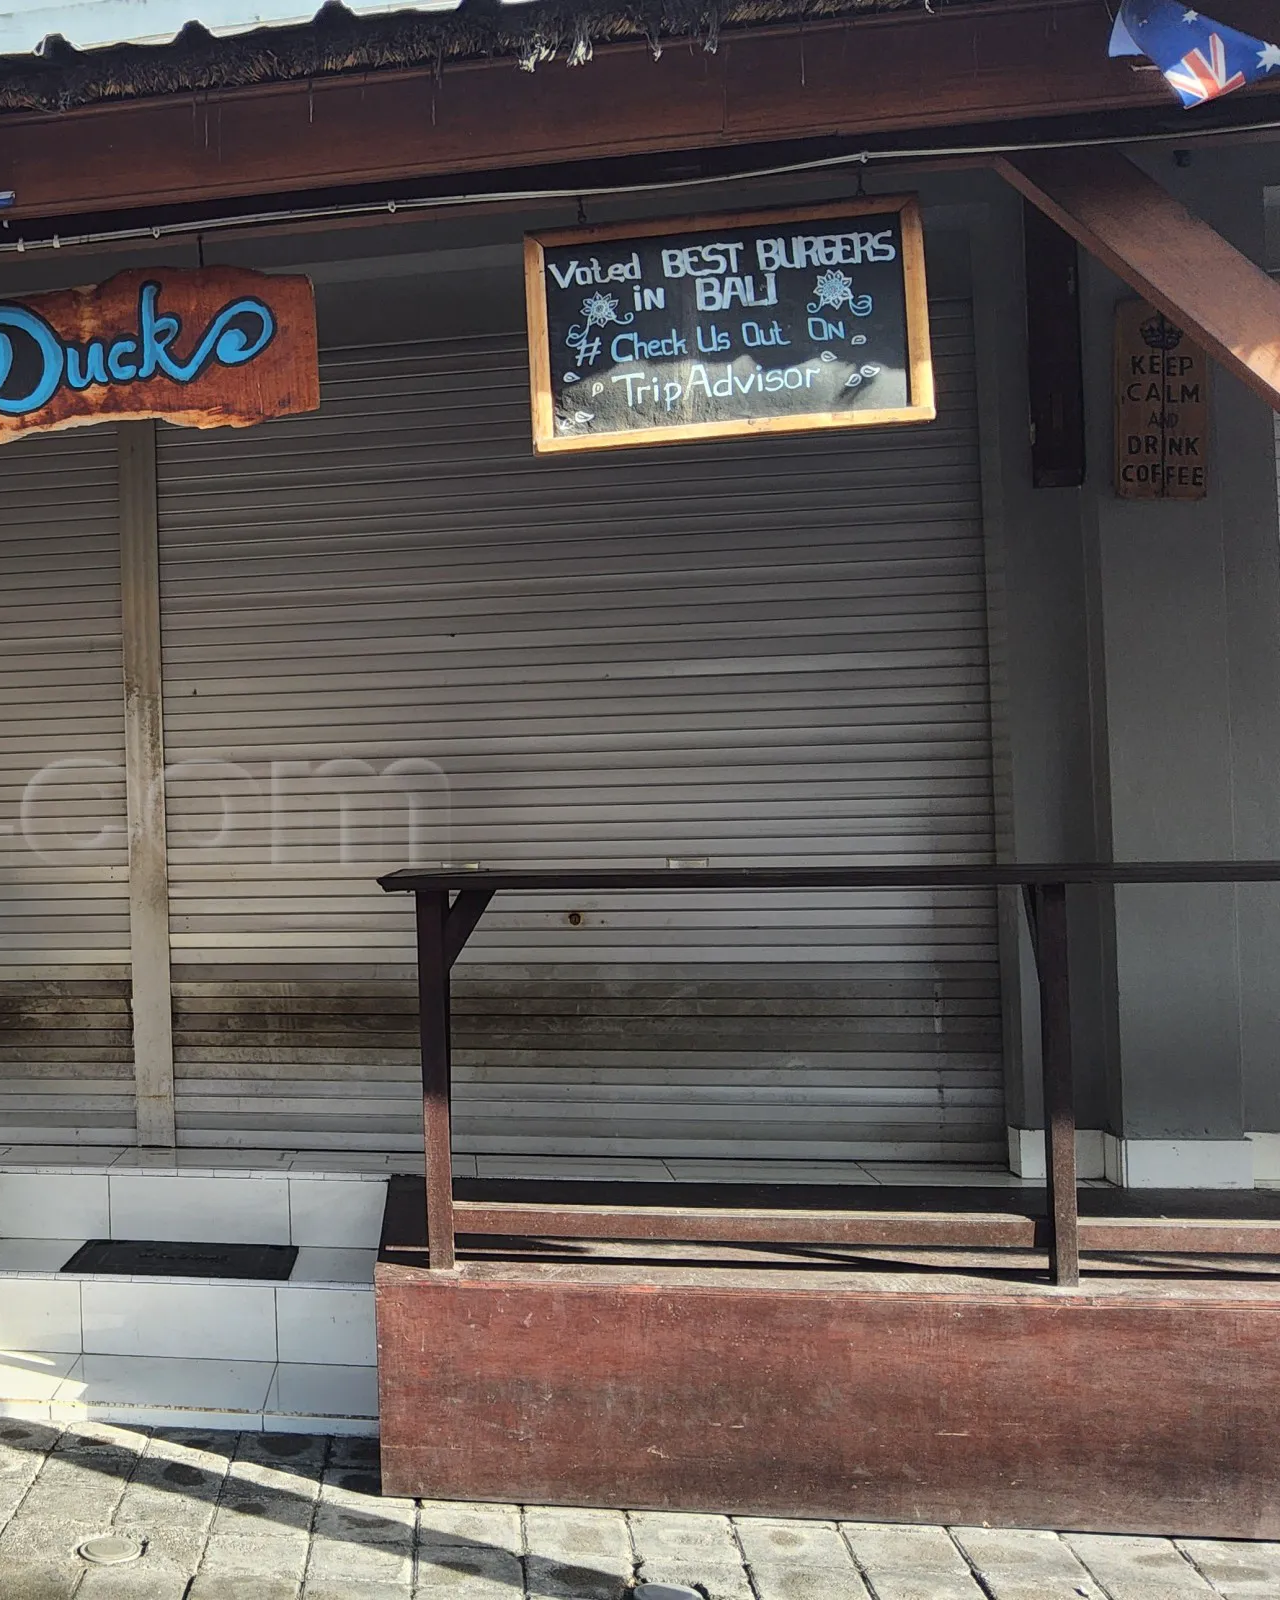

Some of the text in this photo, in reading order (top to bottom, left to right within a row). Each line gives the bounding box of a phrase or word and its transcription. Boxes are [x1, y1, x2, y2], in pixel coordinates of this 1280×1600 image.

[661, 242, 744, 278] BEST
[756, 230, 897, 272] BURGERS
[695, 272, 779, 312] BALI
[610, 329, 688, 364] Check
[696, 324, 731, 353] Us
[741, 319, 791, 347] Out
[1130, 355, 1193, 376] KEEP
[610, 363, 821, 411] TripAdvisor
[1126, 382, 1200, 404] CALM
[1147, 411, 1179, 429] AND
[1127, 435, 1200, 456] DRINK
[1122, 463, 1204, 486] COFFEE
